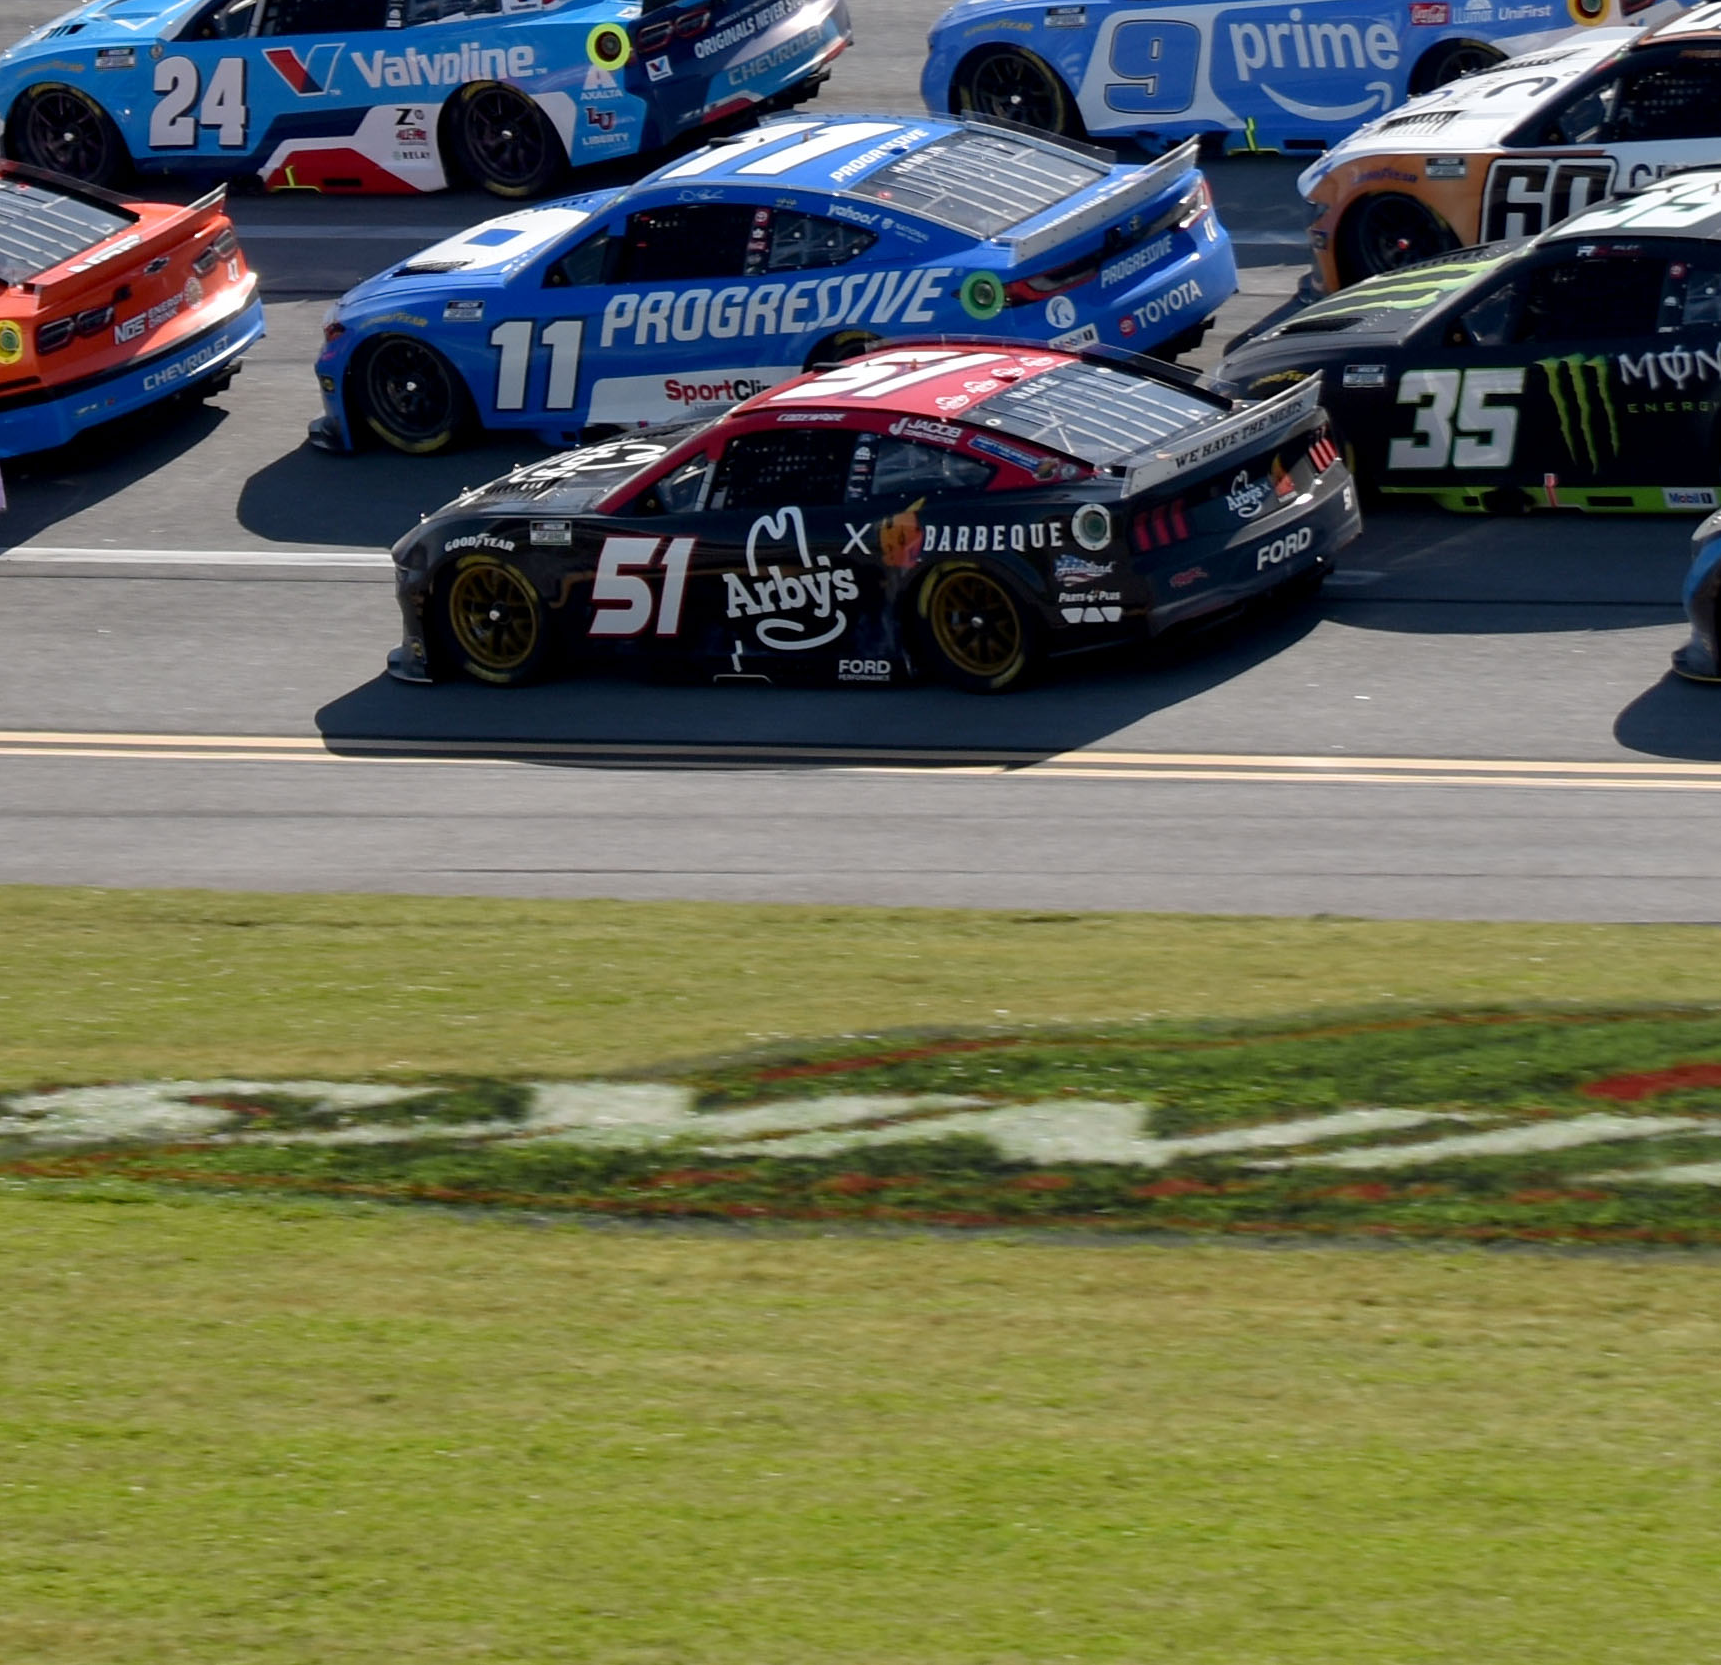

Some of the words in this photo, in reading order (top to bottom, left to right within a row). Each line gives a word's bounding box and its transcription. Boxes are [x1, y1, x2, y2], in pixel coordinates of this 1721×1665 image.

[694, 18, 754, 59] ORIGINALS
[755, 3, 785, 34] NEVER
[1498, 4, 1552, 21] UniFirst
[350, 42, 535, 88] Valvoline
[728, 27, 825, 86] CHEVROLET
[1103, 19, 1202, 115] 9
[1229, 7, 1399, 81] prime
[149, 55, 248, 151] 24
[580, 89, 624, 101] AXALTA
[402, 151, 431, 160] RELAY
[827, 203, 880, 225] yahoo!
[1100, 236, 1173, 289] PROGRESSIVE
[115, 312, 147, 345] NOS
[600, 267, 954, 347] PROGRESSIVE
[1133, 279, 1203, 329] TOYOTA
[143, 335, 230, 392] CHEVROLET
[489, 320, 585, 410] 11
[908, 418, 963, 438] JACOB
[1175, 448, 1197, 470] WE
[1198, 433, 1238, 462] HAVE
[1240, 419, 1265, 444] THE
[1267, 400, 1304, 429] MEATS
[1387, 367, 1526, 470] 35
[1669, 491, 1700, 505] Mobil
[444, 534, 515, 553] GOODYEAR
[922, 522, 1063, 552] BARBEQUE
[1256, 527, 1311, 572] FORD
[587, 535, 697, 637] 51
[723, 555, 860, 618] Arby's
[1059, 591, 1085, 603] PARTS
[1098, 590, 1121, 601] PLUS
[838, 659, 891, 674] FORD
